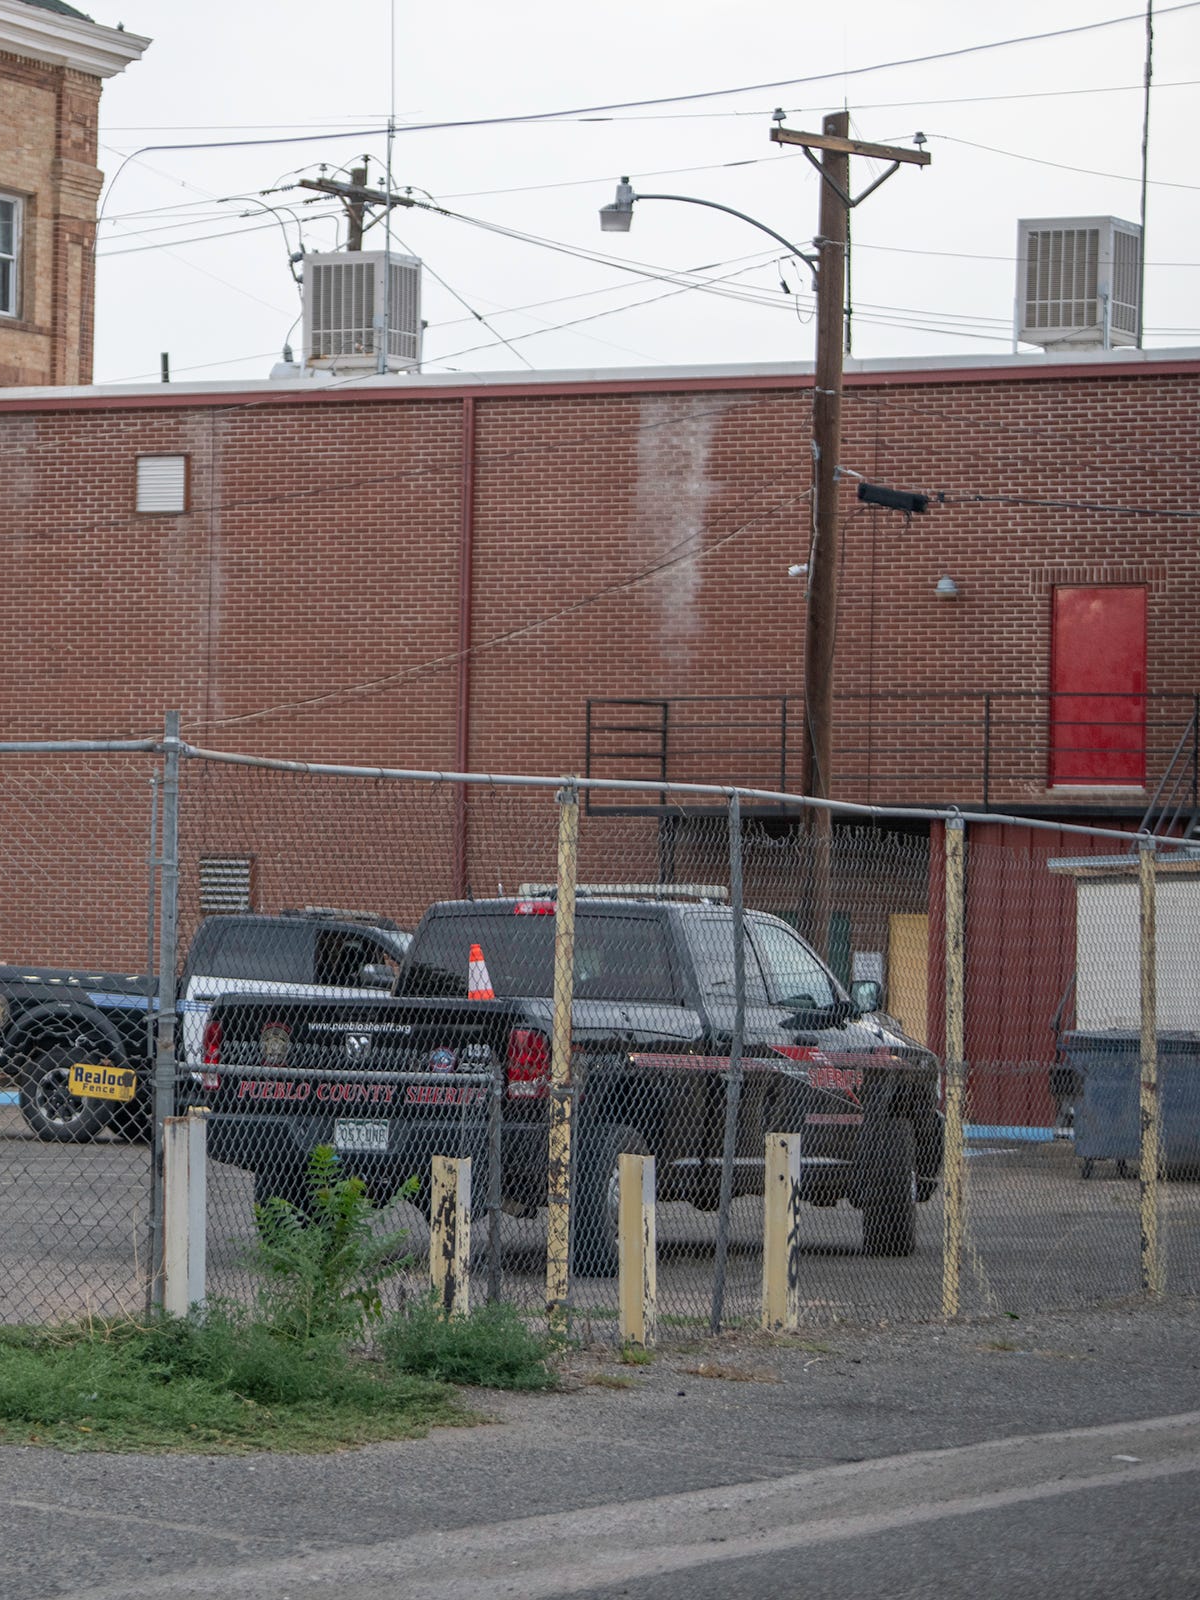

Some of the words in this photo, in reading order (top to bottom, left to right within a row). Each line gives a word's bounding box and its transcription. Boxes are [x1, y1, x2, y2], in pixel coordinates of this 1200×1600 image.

[75, 1067, 133, 1087] Realoc
[82, 1083, 115, 1094] Fence
[237, 1081, 311, 1100] PUEBLO
[316, 1083, 396, 1102] COUNTY
